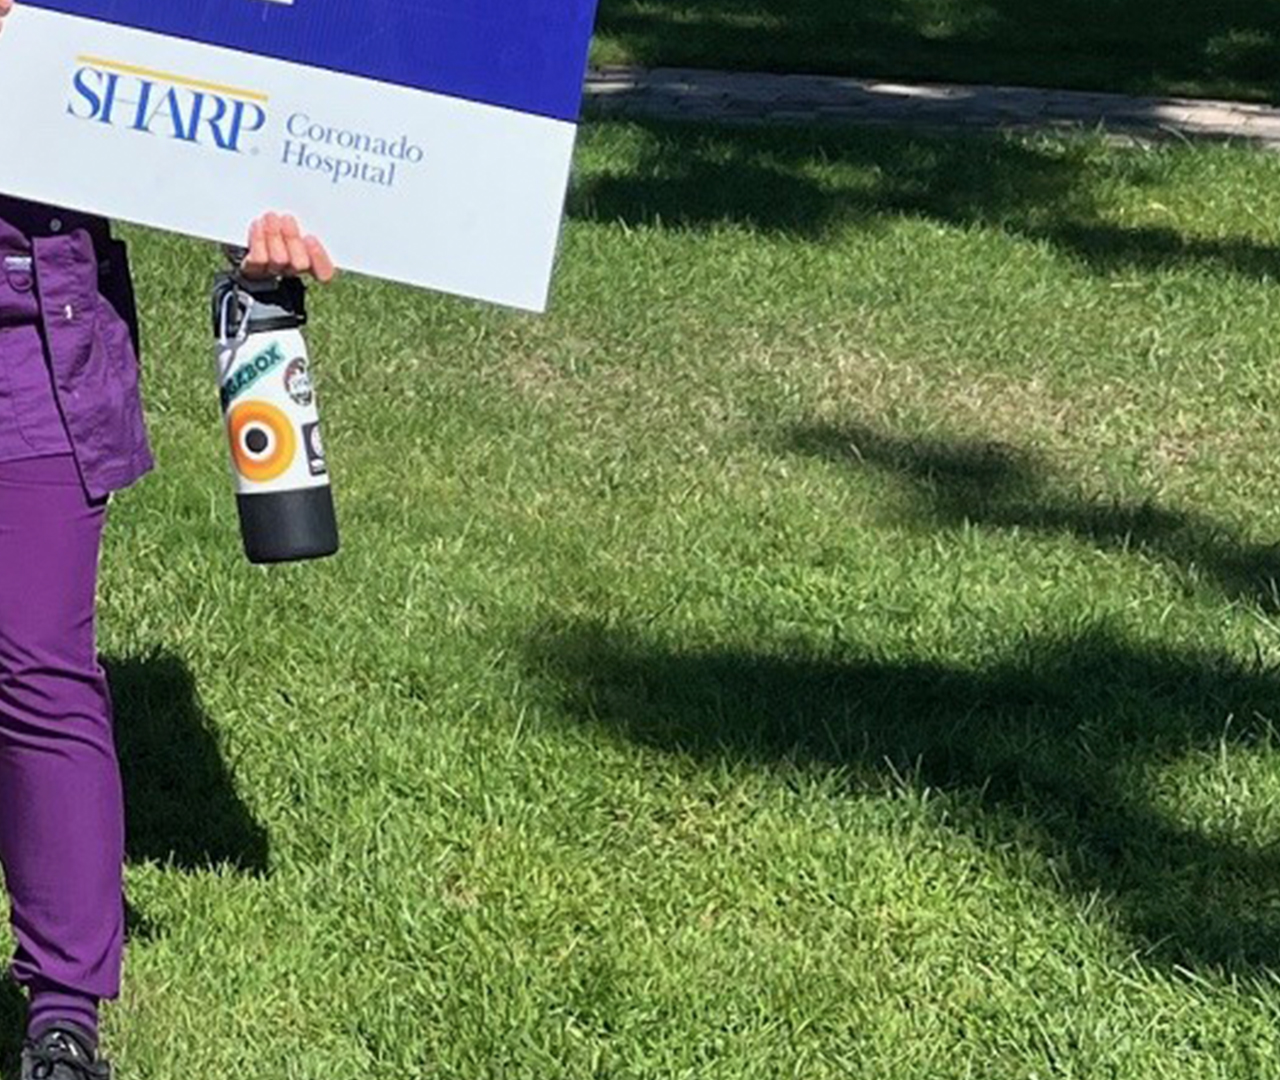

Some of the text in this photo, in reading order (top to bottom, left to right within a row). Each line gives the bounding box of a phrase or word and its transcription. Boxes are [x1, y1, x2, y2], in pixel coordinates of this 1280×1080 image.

[65, 65, 266, 154] SHARP
[280, 139, 396, 187] Hospital
[285, 111, 424, 164] Coronado
